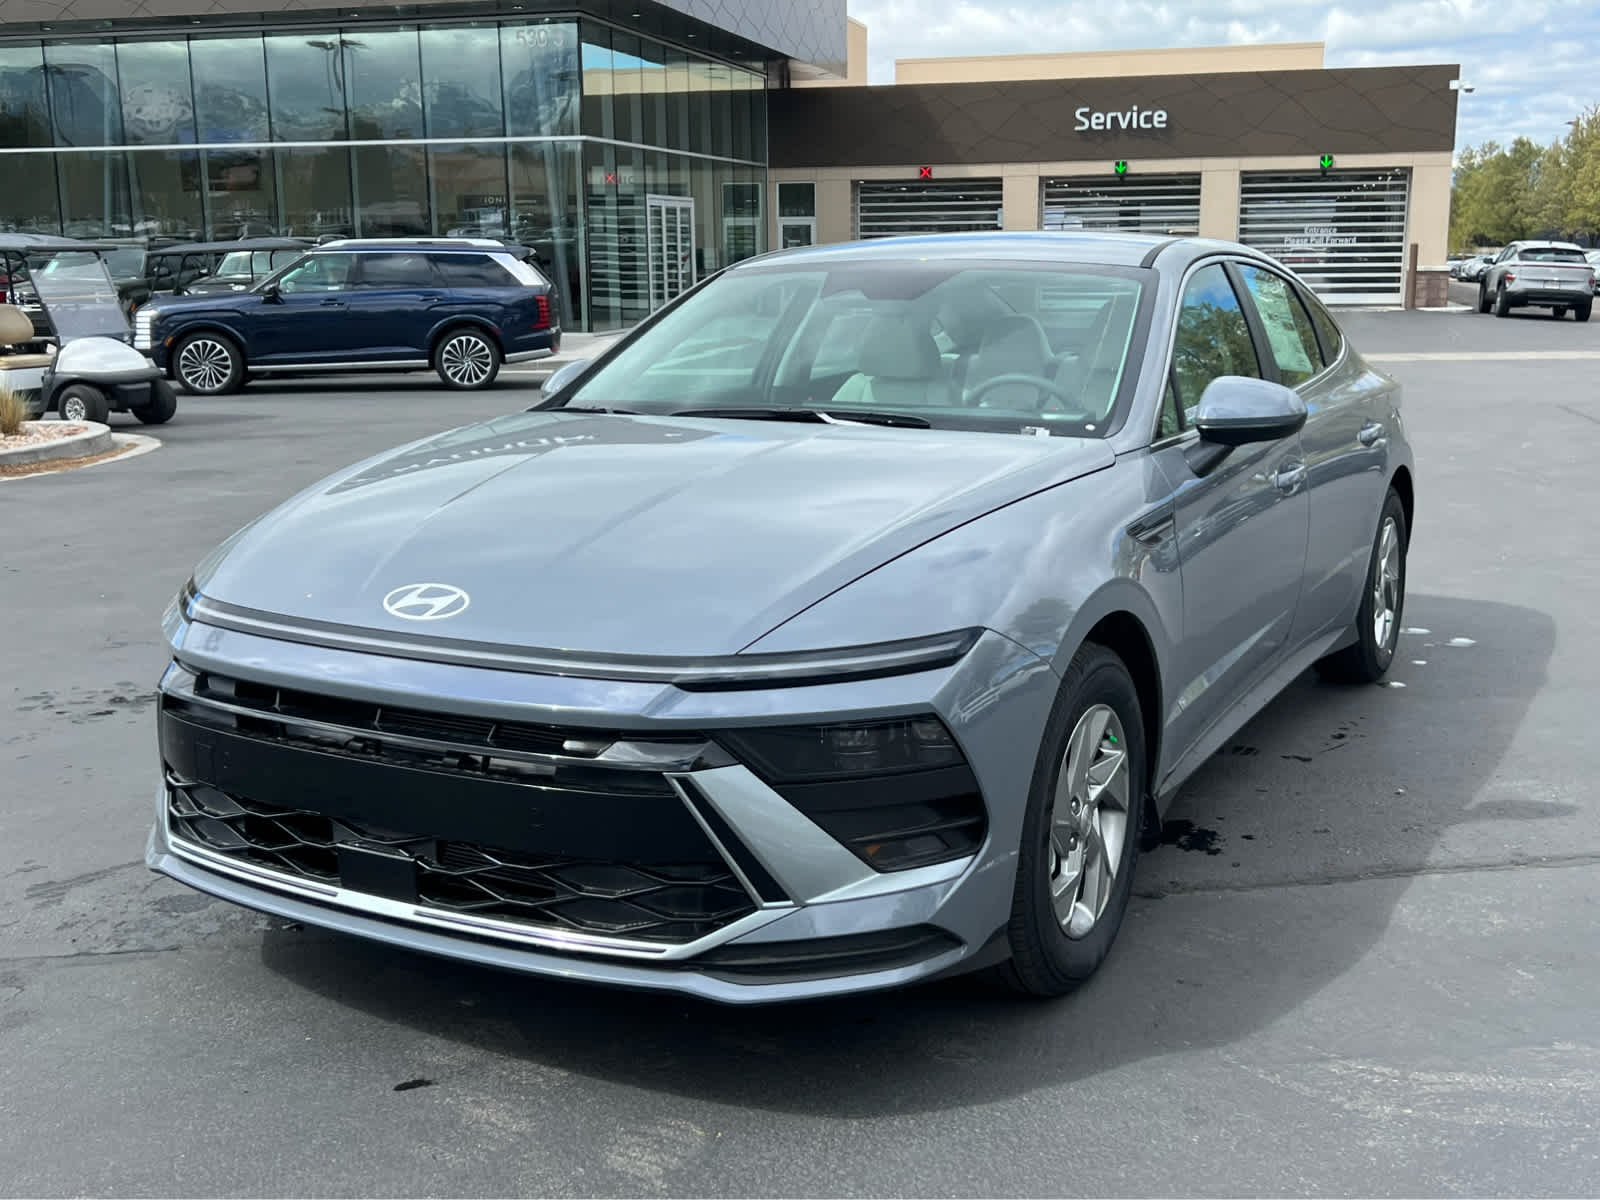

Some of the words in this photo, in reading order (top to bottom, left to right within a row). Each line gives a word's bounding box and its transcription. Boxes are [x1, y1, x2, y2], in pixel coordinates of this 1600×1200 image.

[1074, 104, 1168, 131] Service
[483, 196, 506, 205] IONI
[1304, 224, 1337, 235] Entrance
[1326, 235, 1357, 246] Forward
